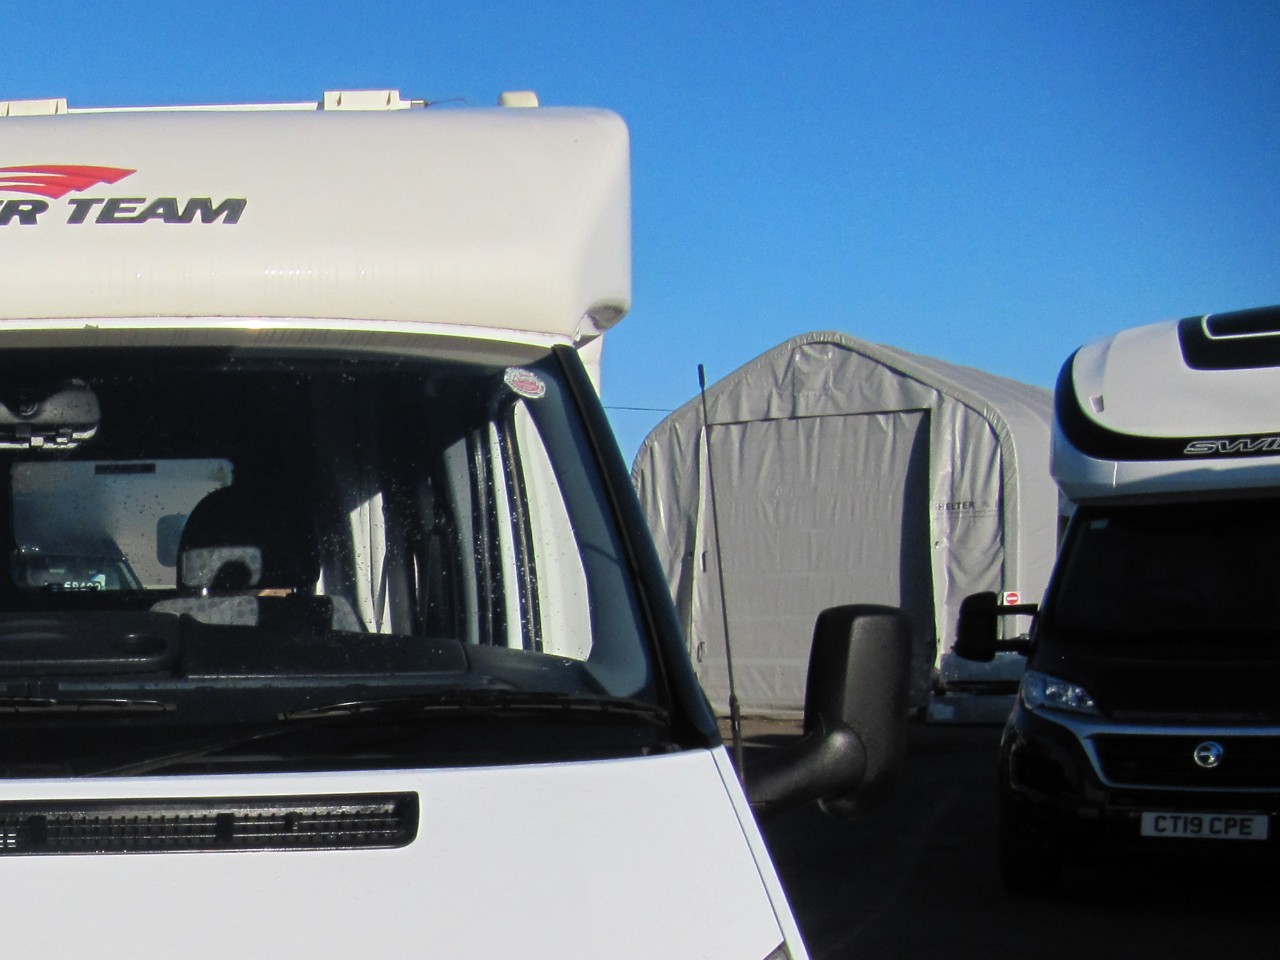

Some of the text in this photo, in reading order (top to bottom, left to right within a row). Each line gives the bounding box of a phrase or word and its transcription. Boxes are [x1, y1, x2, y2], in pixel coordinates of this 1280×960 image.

[67, 197, 248, 225] TEAM
[1154, 815, 1254, 836] CT19 CPE
